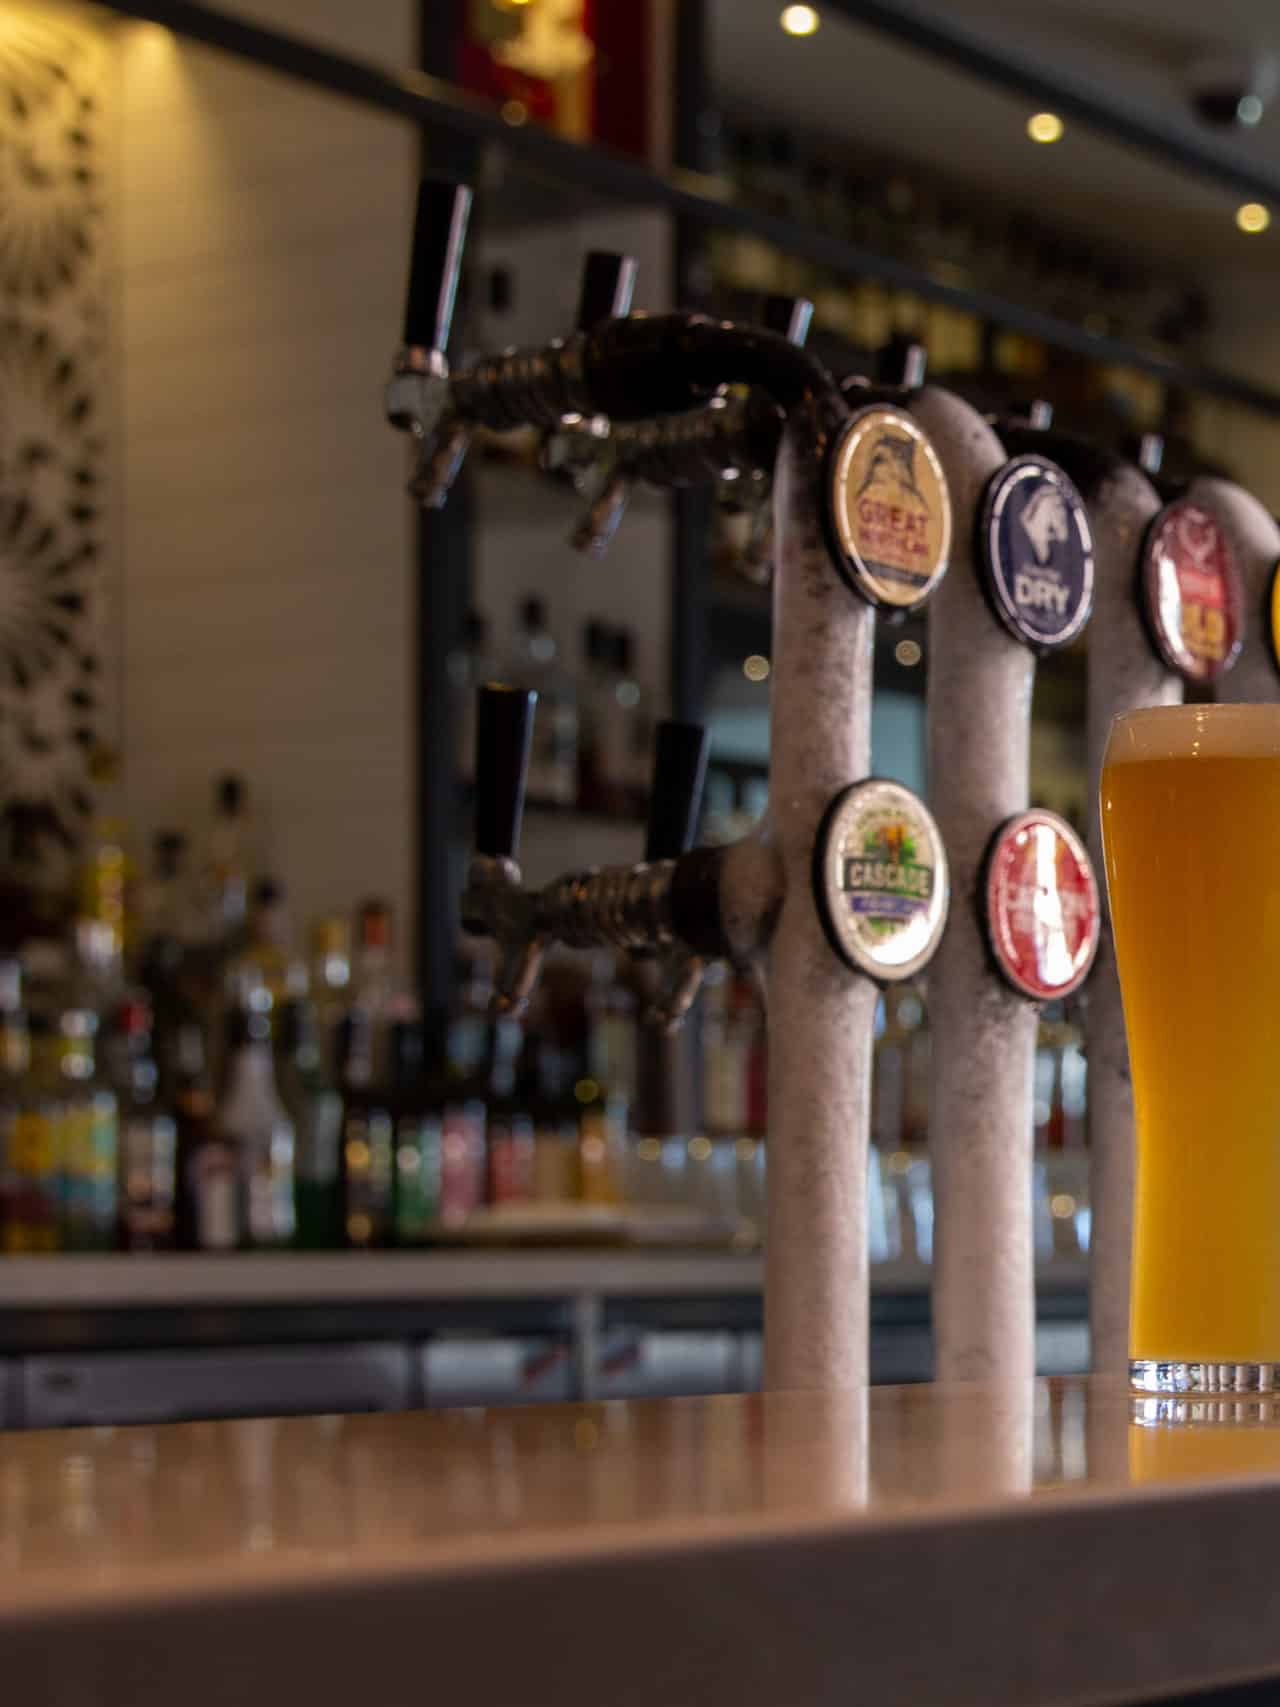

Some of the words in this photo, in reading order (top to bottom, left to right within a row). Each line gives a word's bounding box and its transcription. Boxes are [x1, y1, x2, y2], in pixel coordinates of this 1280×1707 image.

[859, 498, 928, 533] GREAT
[1015, 574, 1071, 613] DRY
[851, 863, 930, 898] CASCADE
